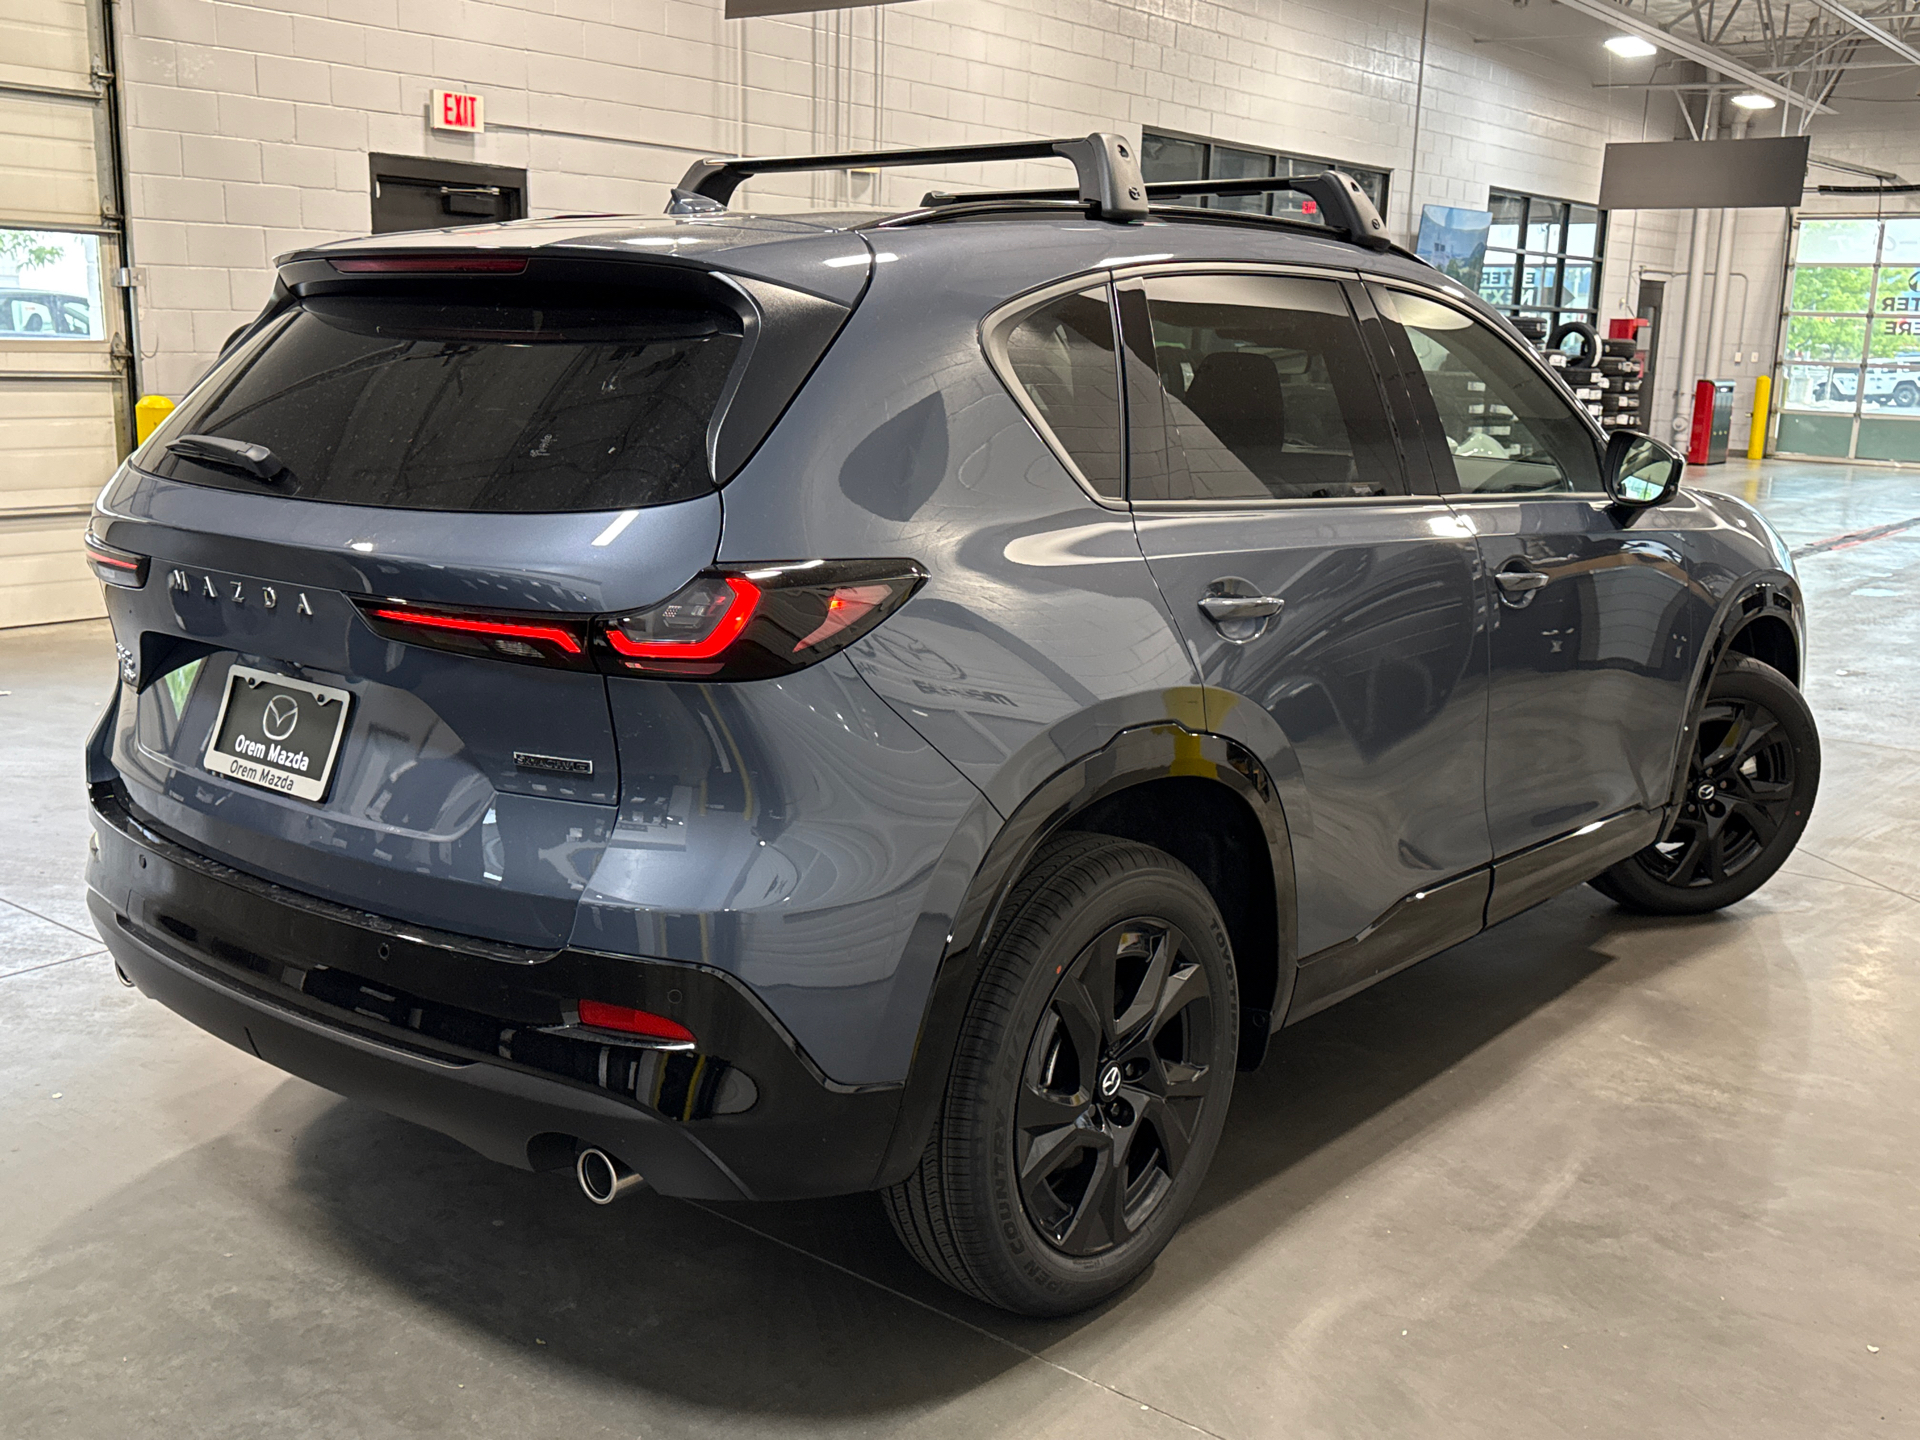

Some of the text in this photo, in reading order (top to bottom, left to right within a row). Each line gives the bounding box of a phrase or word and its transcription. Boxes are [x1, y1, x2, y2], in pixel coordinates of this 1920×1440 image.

[443, 93, 476, 127] EXIT
[173, 569, 314, 615] MAZDA
[234, 734, 310, 772] Orem Mazda
[229, 759, 294, 791] Orem Mazda
